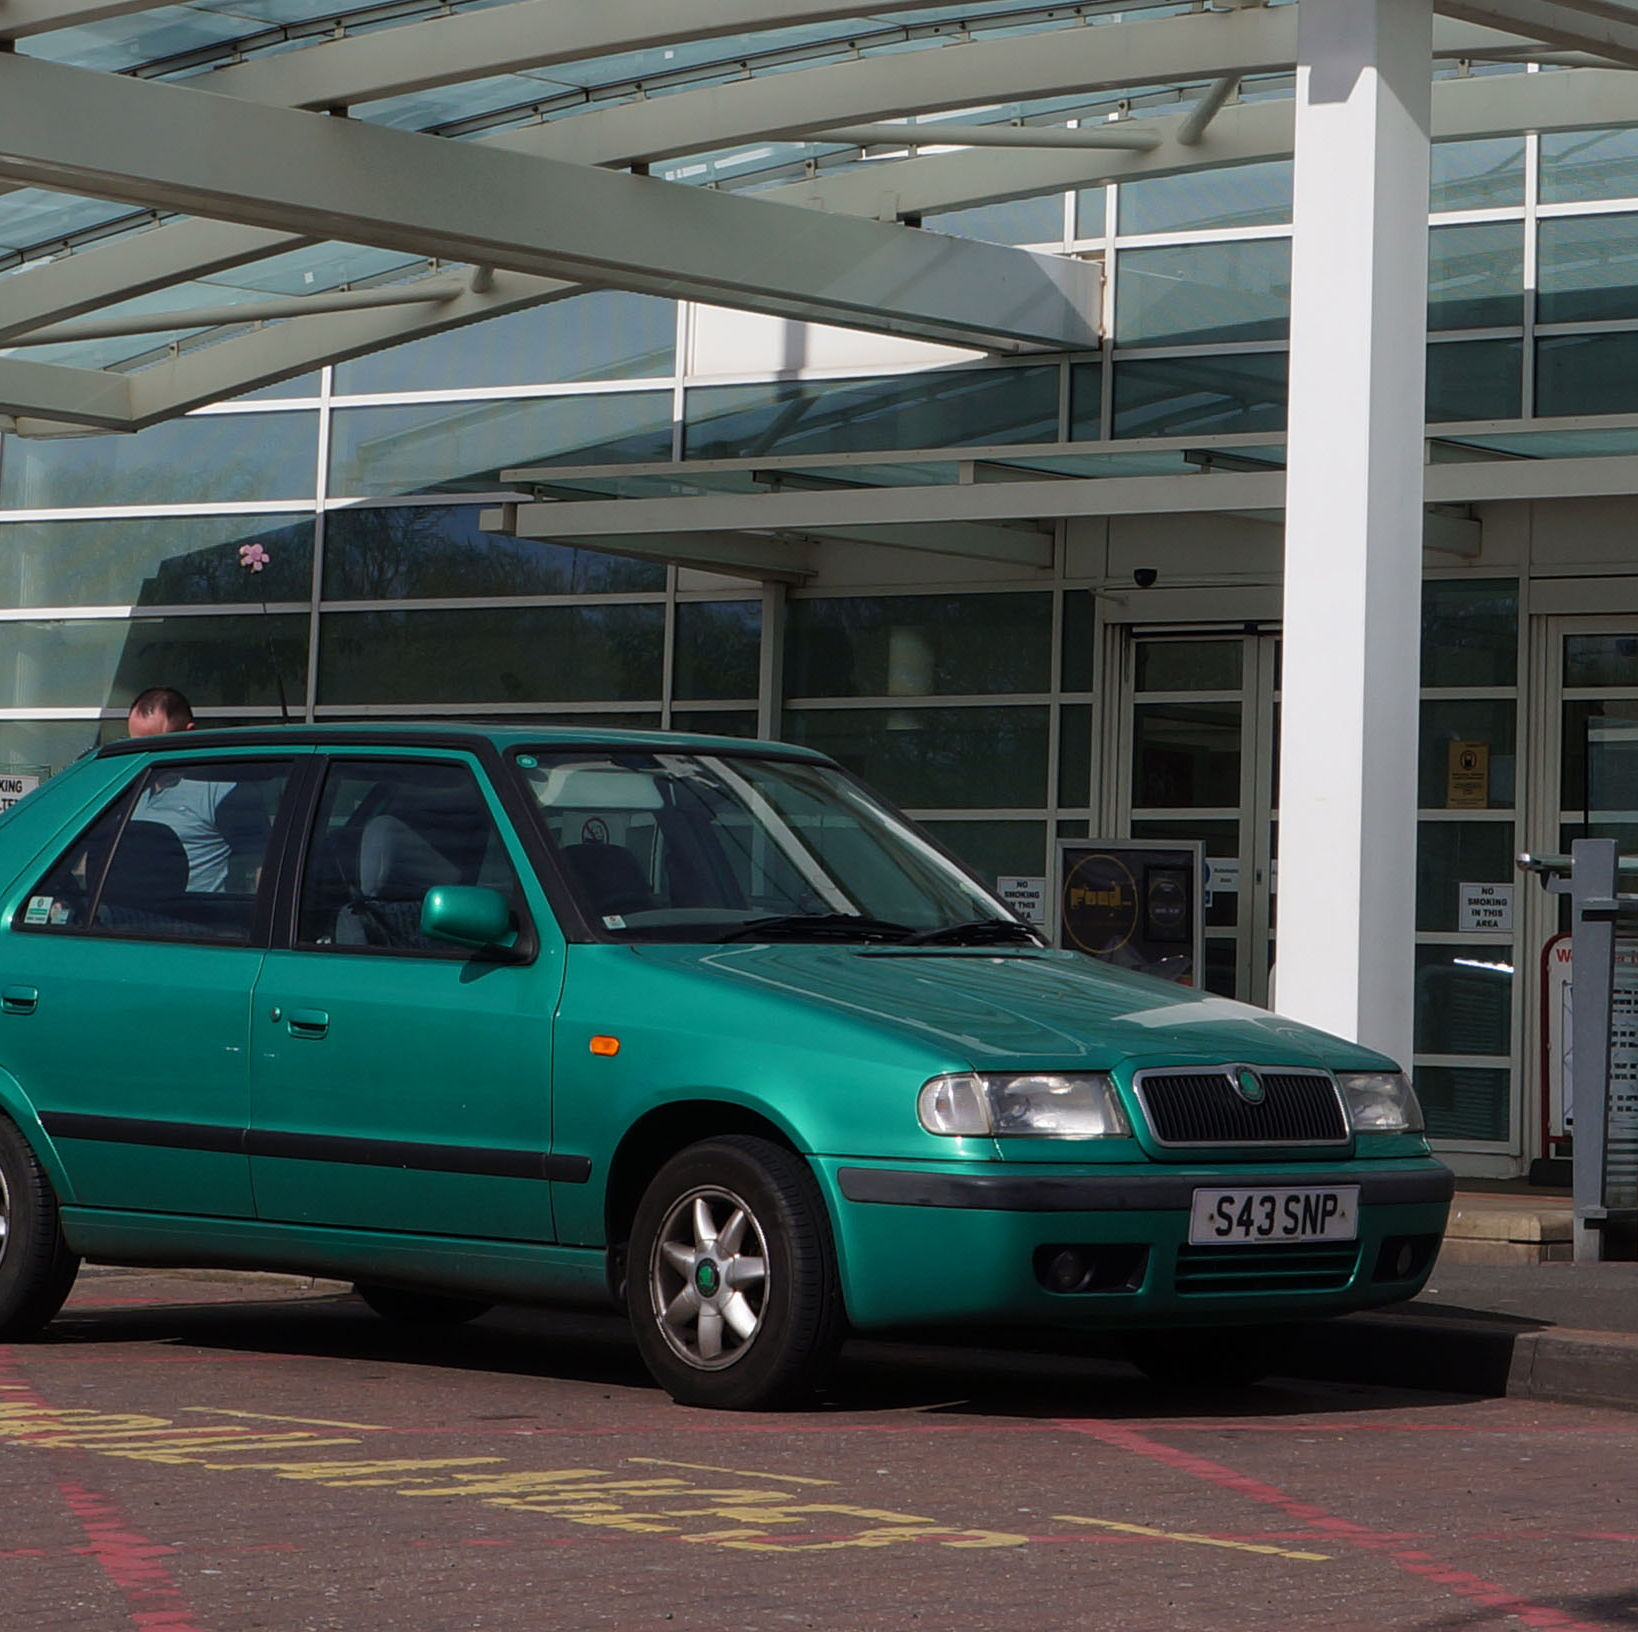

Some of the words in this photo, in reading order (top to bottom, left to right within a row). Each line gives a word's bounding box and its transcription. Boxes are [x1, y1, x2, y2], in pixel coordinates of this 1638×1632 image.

[1004, 891, 1040, 899] SMOKING
[1481, 887, 1494, 895] NO
[1467, 897, 1508, 906] SMOKING
[1471, 908, 1481, 917] IN
[1483, 909, 1503, 917] THIS
[1475, 919, 1499, 928] AREA
[1215, 1194, 1277, 1238] S43
[1282, 1193, 1339, 1236] SNP
